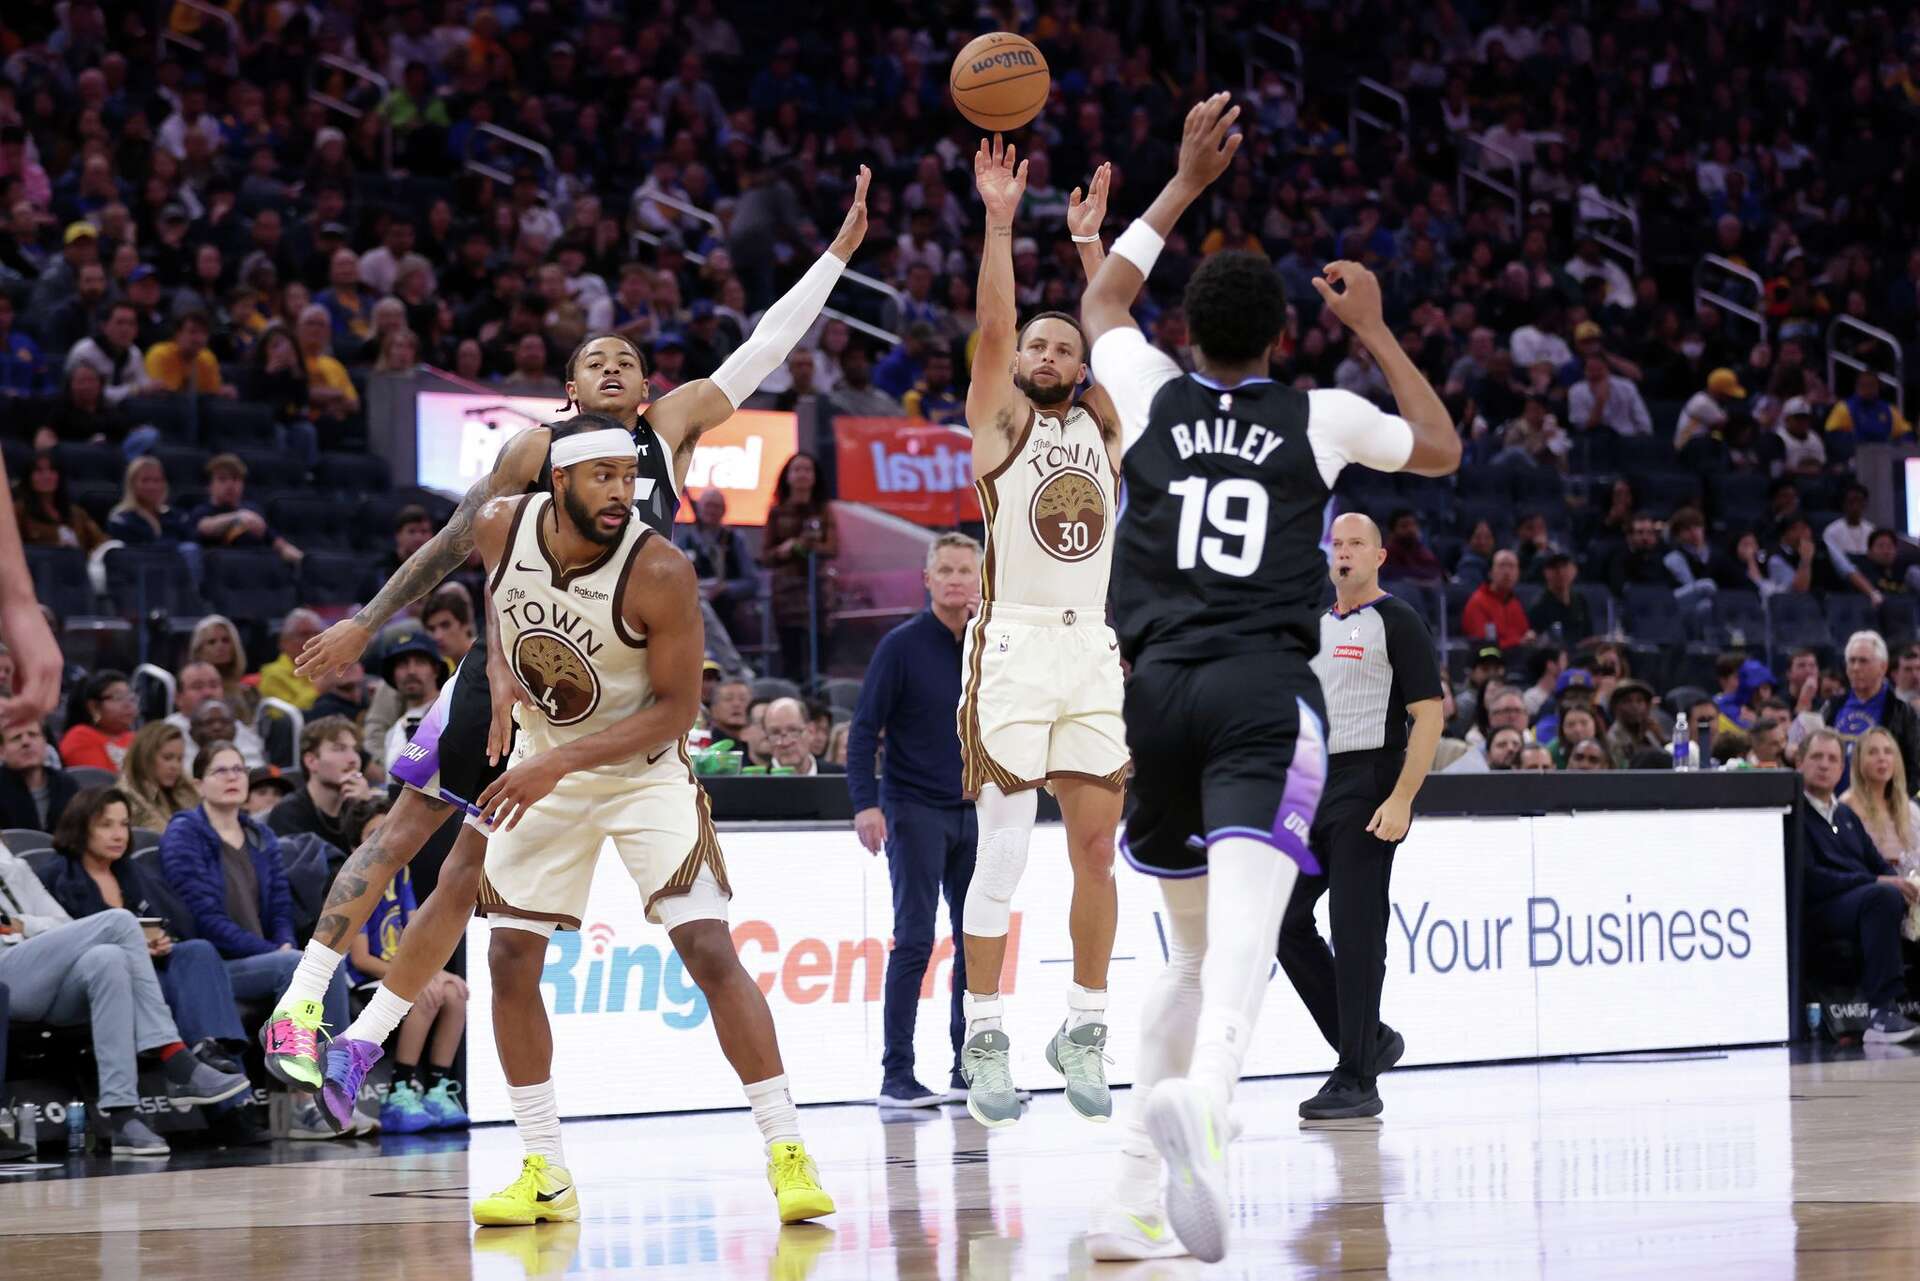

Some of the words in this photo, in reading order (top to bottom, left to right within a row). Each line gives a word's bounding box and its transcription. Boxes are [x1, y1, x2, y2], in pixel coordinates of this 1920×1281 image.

[972, 51, 1036, 73] Wilson
[1032, 439, 1052, 453] The
[1171, 418, 1285, 466] BAILEY
[1027, 443, 1100, 478] TOWN
[1058, 521, 1088, 552] 30
[1168, 475, 1269, 577] 19
[507, 588, 526, 602] The
[574, 585, 609, 601] Rakuten
[503, 601, 604, 658] TOWN
[542, 686, 558, 716] 4
[1392, 901, 1512, 974] Your
[1527, 894, 1751, 967] Business
